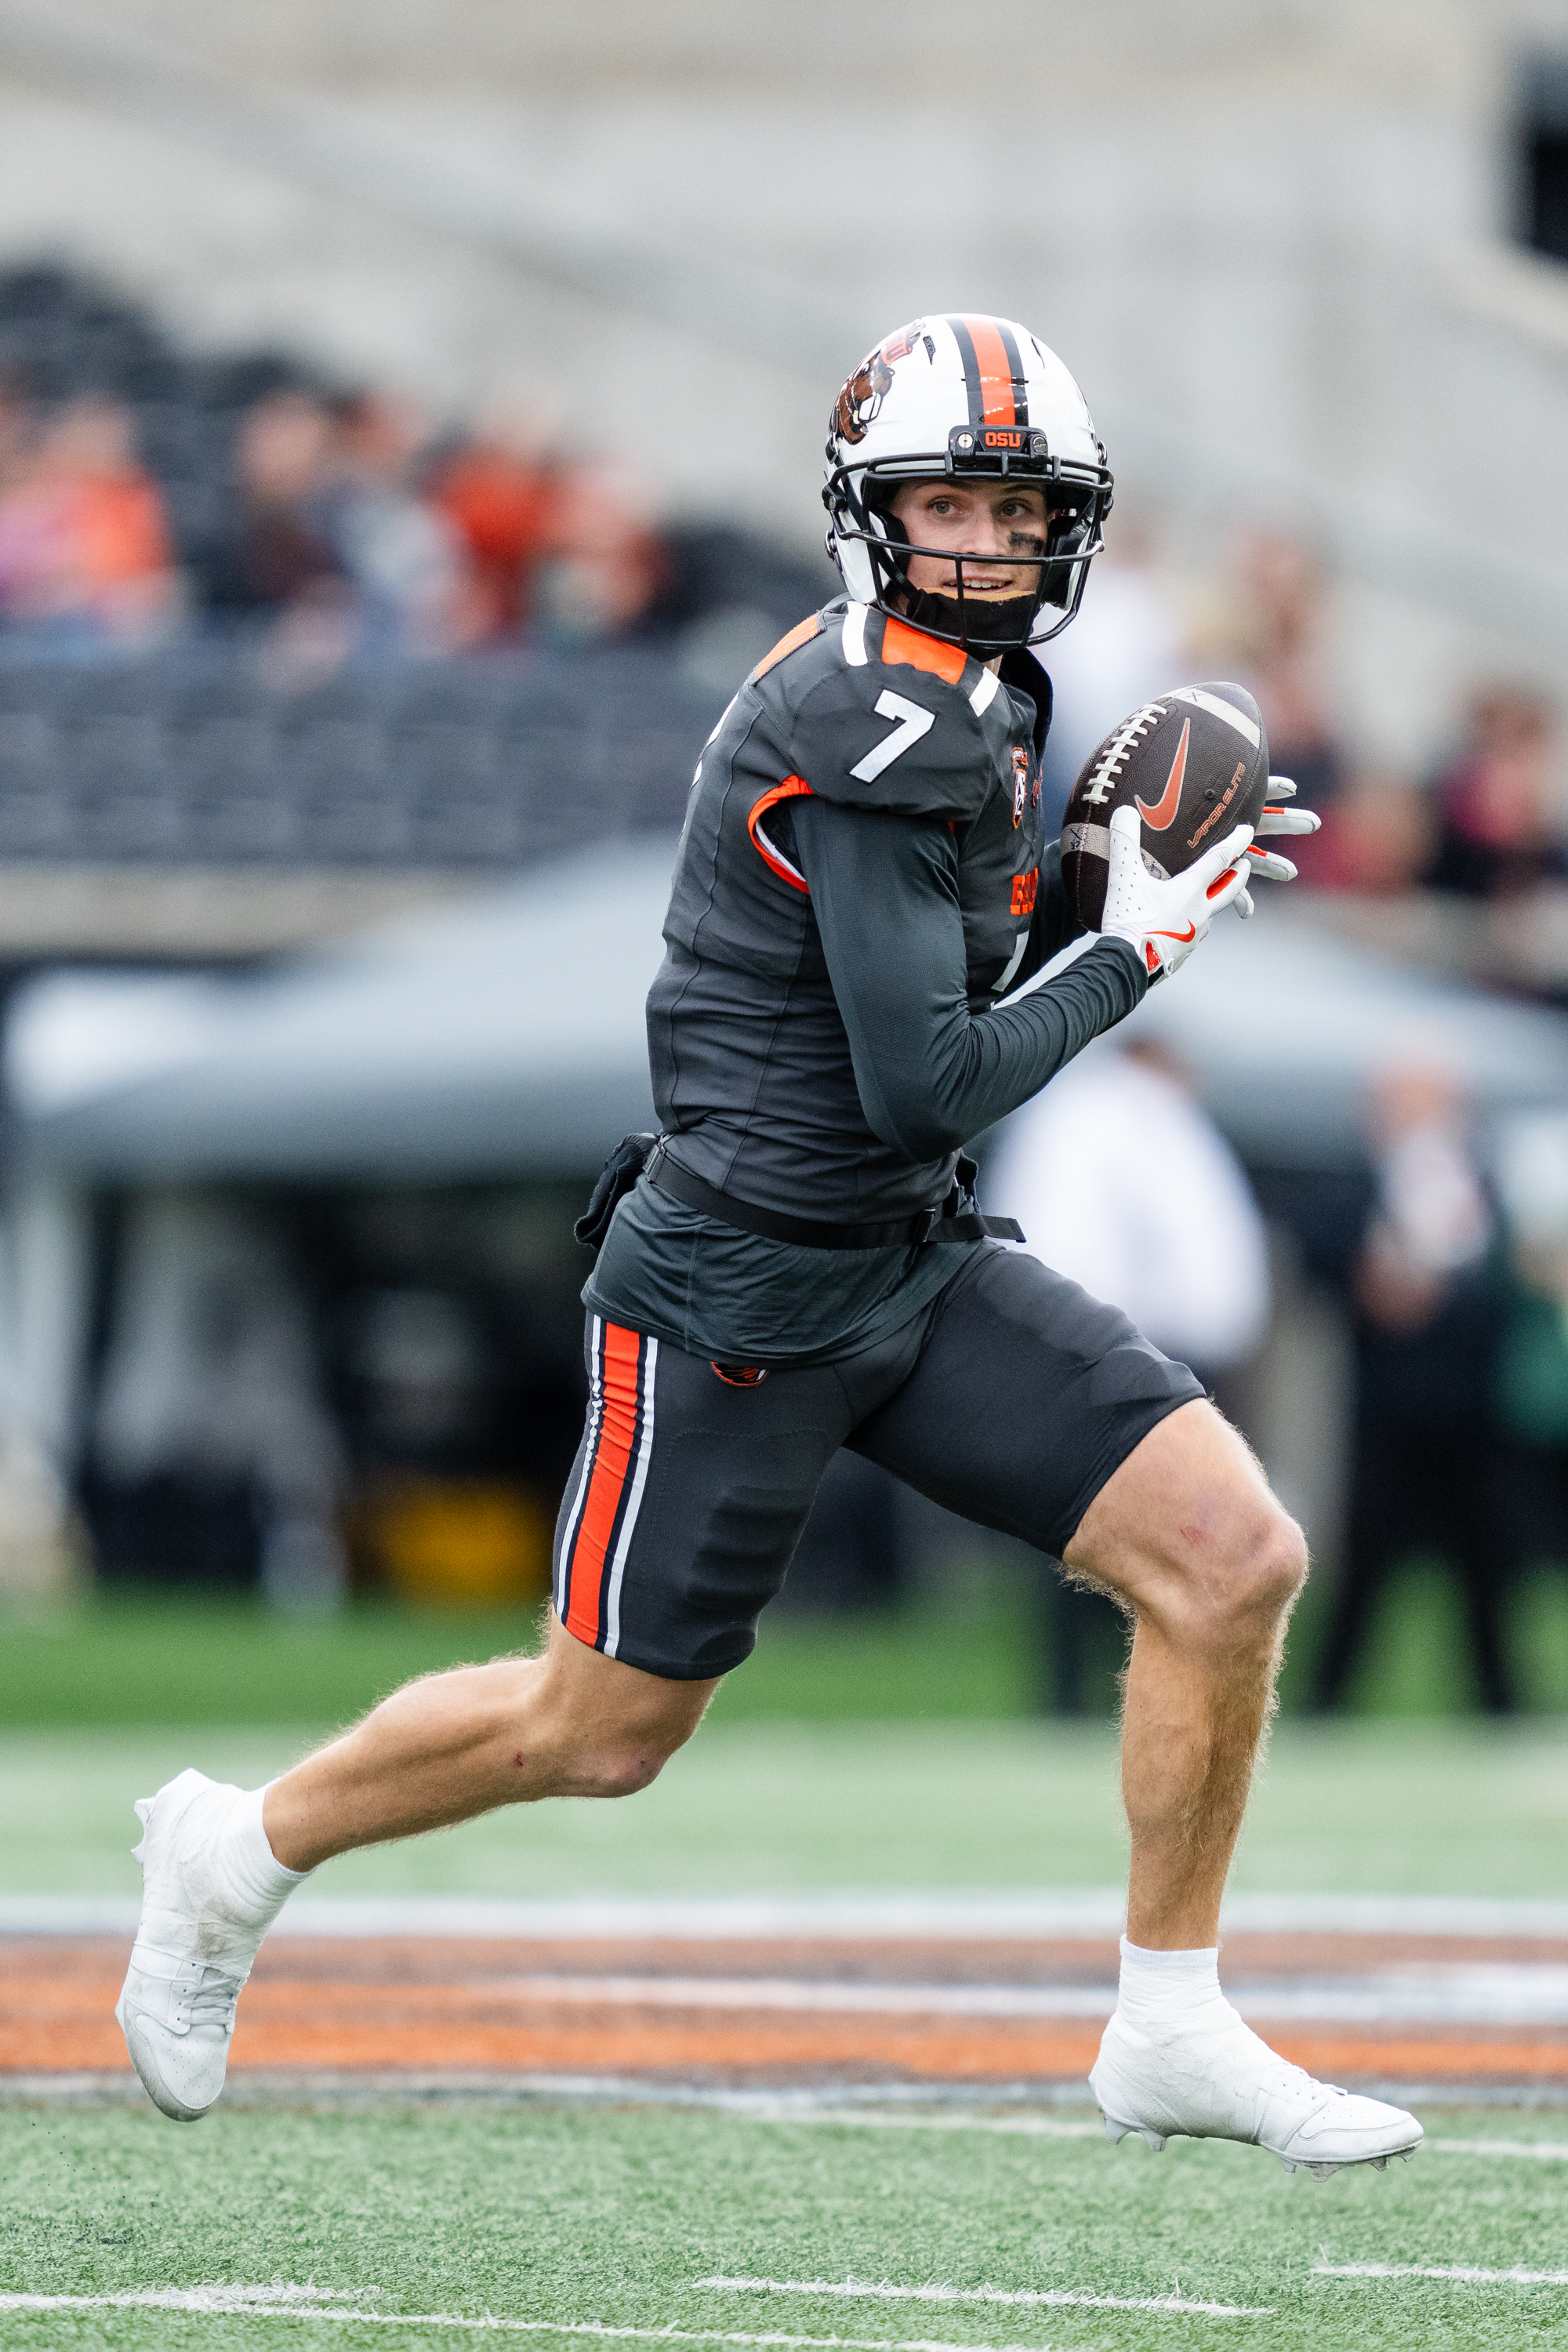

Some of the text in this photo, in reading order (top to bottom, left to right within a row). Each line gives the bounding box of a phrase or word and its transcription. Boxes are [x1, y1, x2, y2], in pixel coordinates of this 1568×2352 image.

[985, 432, 1021, 448] OSU
[849, 688, 936, 784] 7
[1186, 761, 1247, 848] VAPOR ELITE
